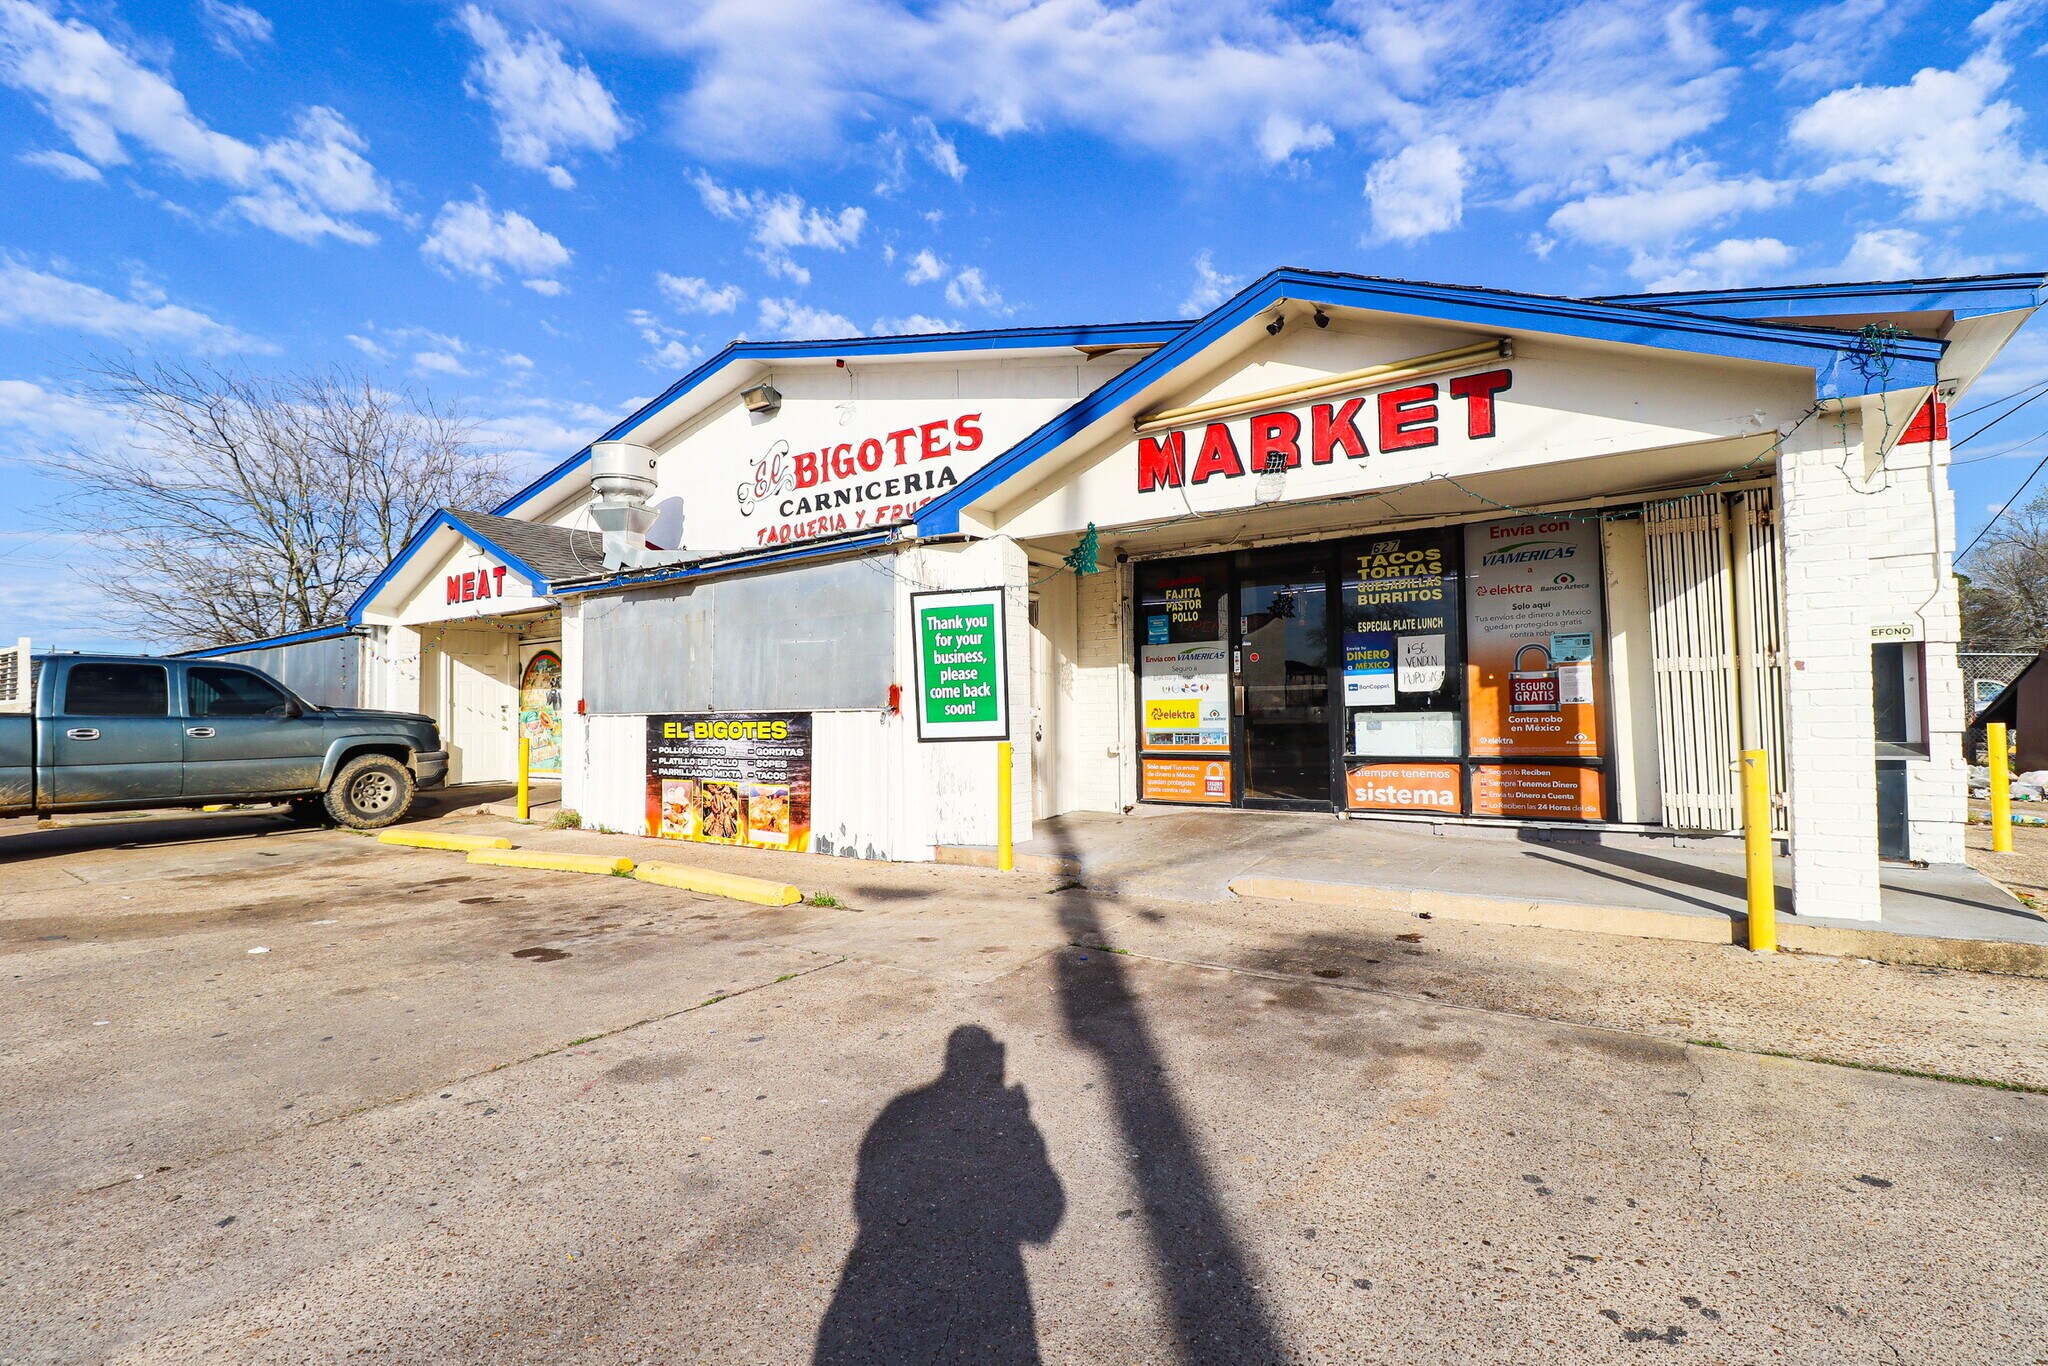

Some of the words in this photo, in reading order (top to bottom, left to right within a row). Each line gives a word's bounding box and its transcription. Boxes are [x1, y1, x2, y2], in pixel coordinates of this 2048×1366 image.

[1137, 368, 1513, 493] MARKET
[791, 412, 984, 491] BIGOTES
[779, 465, 958, 518] CARNICERIA
[756, 513, 847, 546] TAQUERIA
[855, 508, 866, 529] Y
[874, 495, 938, 525] FRUT
[1490, 522, 1534, 539] Envía
[1538, 520, 1570, 534] con
[1373, 540, 1399, 554] 627
[1356, 548, 1442, 568] TACOS
[1481, 546, 1578, 567] VIAMERICAS
[1357, 561, 1443, 580] TORTAS
[446, 565, 507, 605] MEAT
[1357, 575, 1442, 593] QUESADILLAS
[1489, 584, 1533, 596] elektra
[1564, 582, 1590, 590] Azteca
[1165, 587, 1201, 601] FAJITA
[1357, 588, 1443, 606] BURRITOS
[1166, 598, 1202, 612] PASTOR
[1512, 602, 1531, 611] Solo
[1532, 600, 1551, 610] aquí
[1172, 611, 1199, 623] POLLO
[1489, 613, 1514, 621] envíos
[1515, 612, 1526, 620] de
[1527, 611, 1554, 619] dinero
[1562, 608, 1592, 617] México
[926, 614, 964, 631] Thank
[965, 616, 988, 632] you
[1357, 619, 1392, 633] ESPECIAL
[1392, 618, 1416, 631] PLATE
[1417, 616, 1444, 629] LUNCH
[1483, 623, 1513, 632] quedan
[1515, 620, 1558, 630] protegidos
[1559, 618, 1583, 628] gratis
[1509, 631, 1534, 639] contra
[1871, 627, 1911, 637] EFONO
[934, 632, 952, 647] for
[955, 633, 983, 650] your
[933, 649, 987, 665] business,
[1177, 651, 1226, 661] VIAMERICAS
[1171, 665, 1192, 673] Seguro
[1355, 660, 1390, 670] MÉXICO
[940, 666, 978, 684] please
[930, 686, 960, 699] come
[963, 682, 991, 698] back
[1514, 682, 1554, 691] SEGURO
[1515, 690, 1555, 701] GRATIS
[944, 700, 976, 716] soon!
[1163, 710, 1196, 720] elektra
[1508, 716, 1539, 724] Contra
[1541, 715, 1563, 723] robo
[663, 721, 689, 740] EL
[693, 720, 789, 741] BIGOTES
[1525, 723, 1561, 732] México
[1487, 737, 1514, 745] elektra
[658, 746, 690, 756] POLLOS
[691, 746, 727, 757] ASADOS
[755, 747, 805, 758] GORDITAS
[658, 757, 695, 767] PLATILLO
[697, 758, 709, 767] DE
[709, 758, 739, 768] POLLO
[755, 759, 788, 769] SOPES
[658, 768, 713, 779] PARRILLADAS
[714, 769, 743, 780] MIXTA
[755, 771, 787, 781] TACOS
[1355, 769, 1399, 780] Siempre
[1401, 769, 1451, 779] tenemos
[1488, 768, 1513, 777] Seguro
[1521, 768, 1551, 776] Reciben
[1167, 779, 1196, 787] protegidos
[1488, 780, 1517, 788] Siempre
[1517, 780, 1552, 788] Tenemos
[1552, 780, 1578, 789] Dinero
[1355, 781, 1455, 806] sistema
[1515, 791, 1541, 799] Dinero
[1547, 792, 1575, 800] Cuenta
[1499, 802, 1526, 810] Reciben
[1537, 803, 1547, 811] 24
[1548, 803, 1571, 811] Horas
[1572, 804, 1584, 812] del
